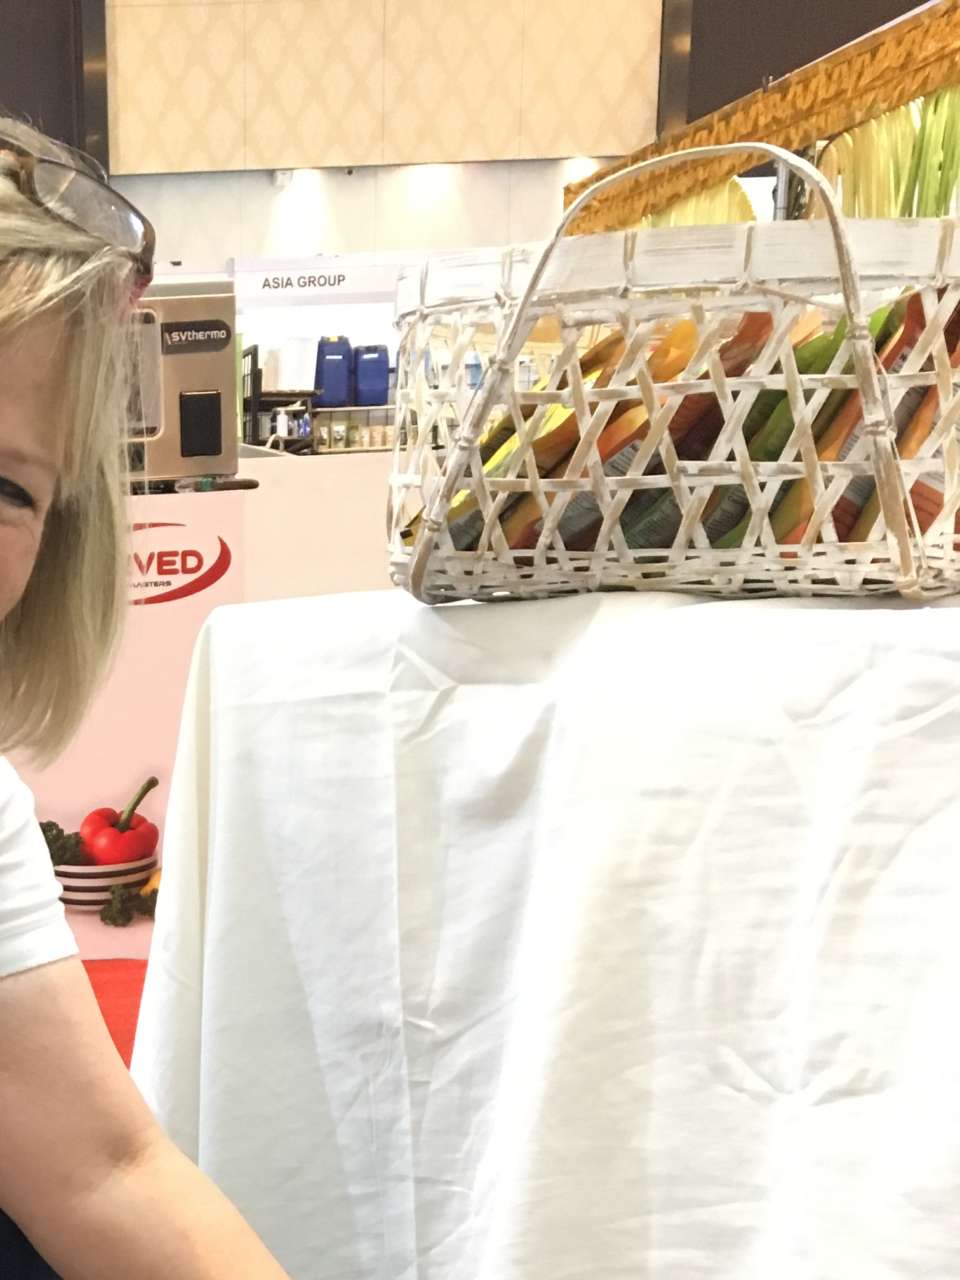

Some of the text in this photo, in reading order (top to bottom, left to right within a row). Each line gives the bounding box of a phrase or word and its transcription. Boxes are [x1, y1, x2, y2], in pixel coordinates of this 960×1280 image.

[262, 274, 346, 289] ASIA GROUP
[132, 549, 204, 576] VED
